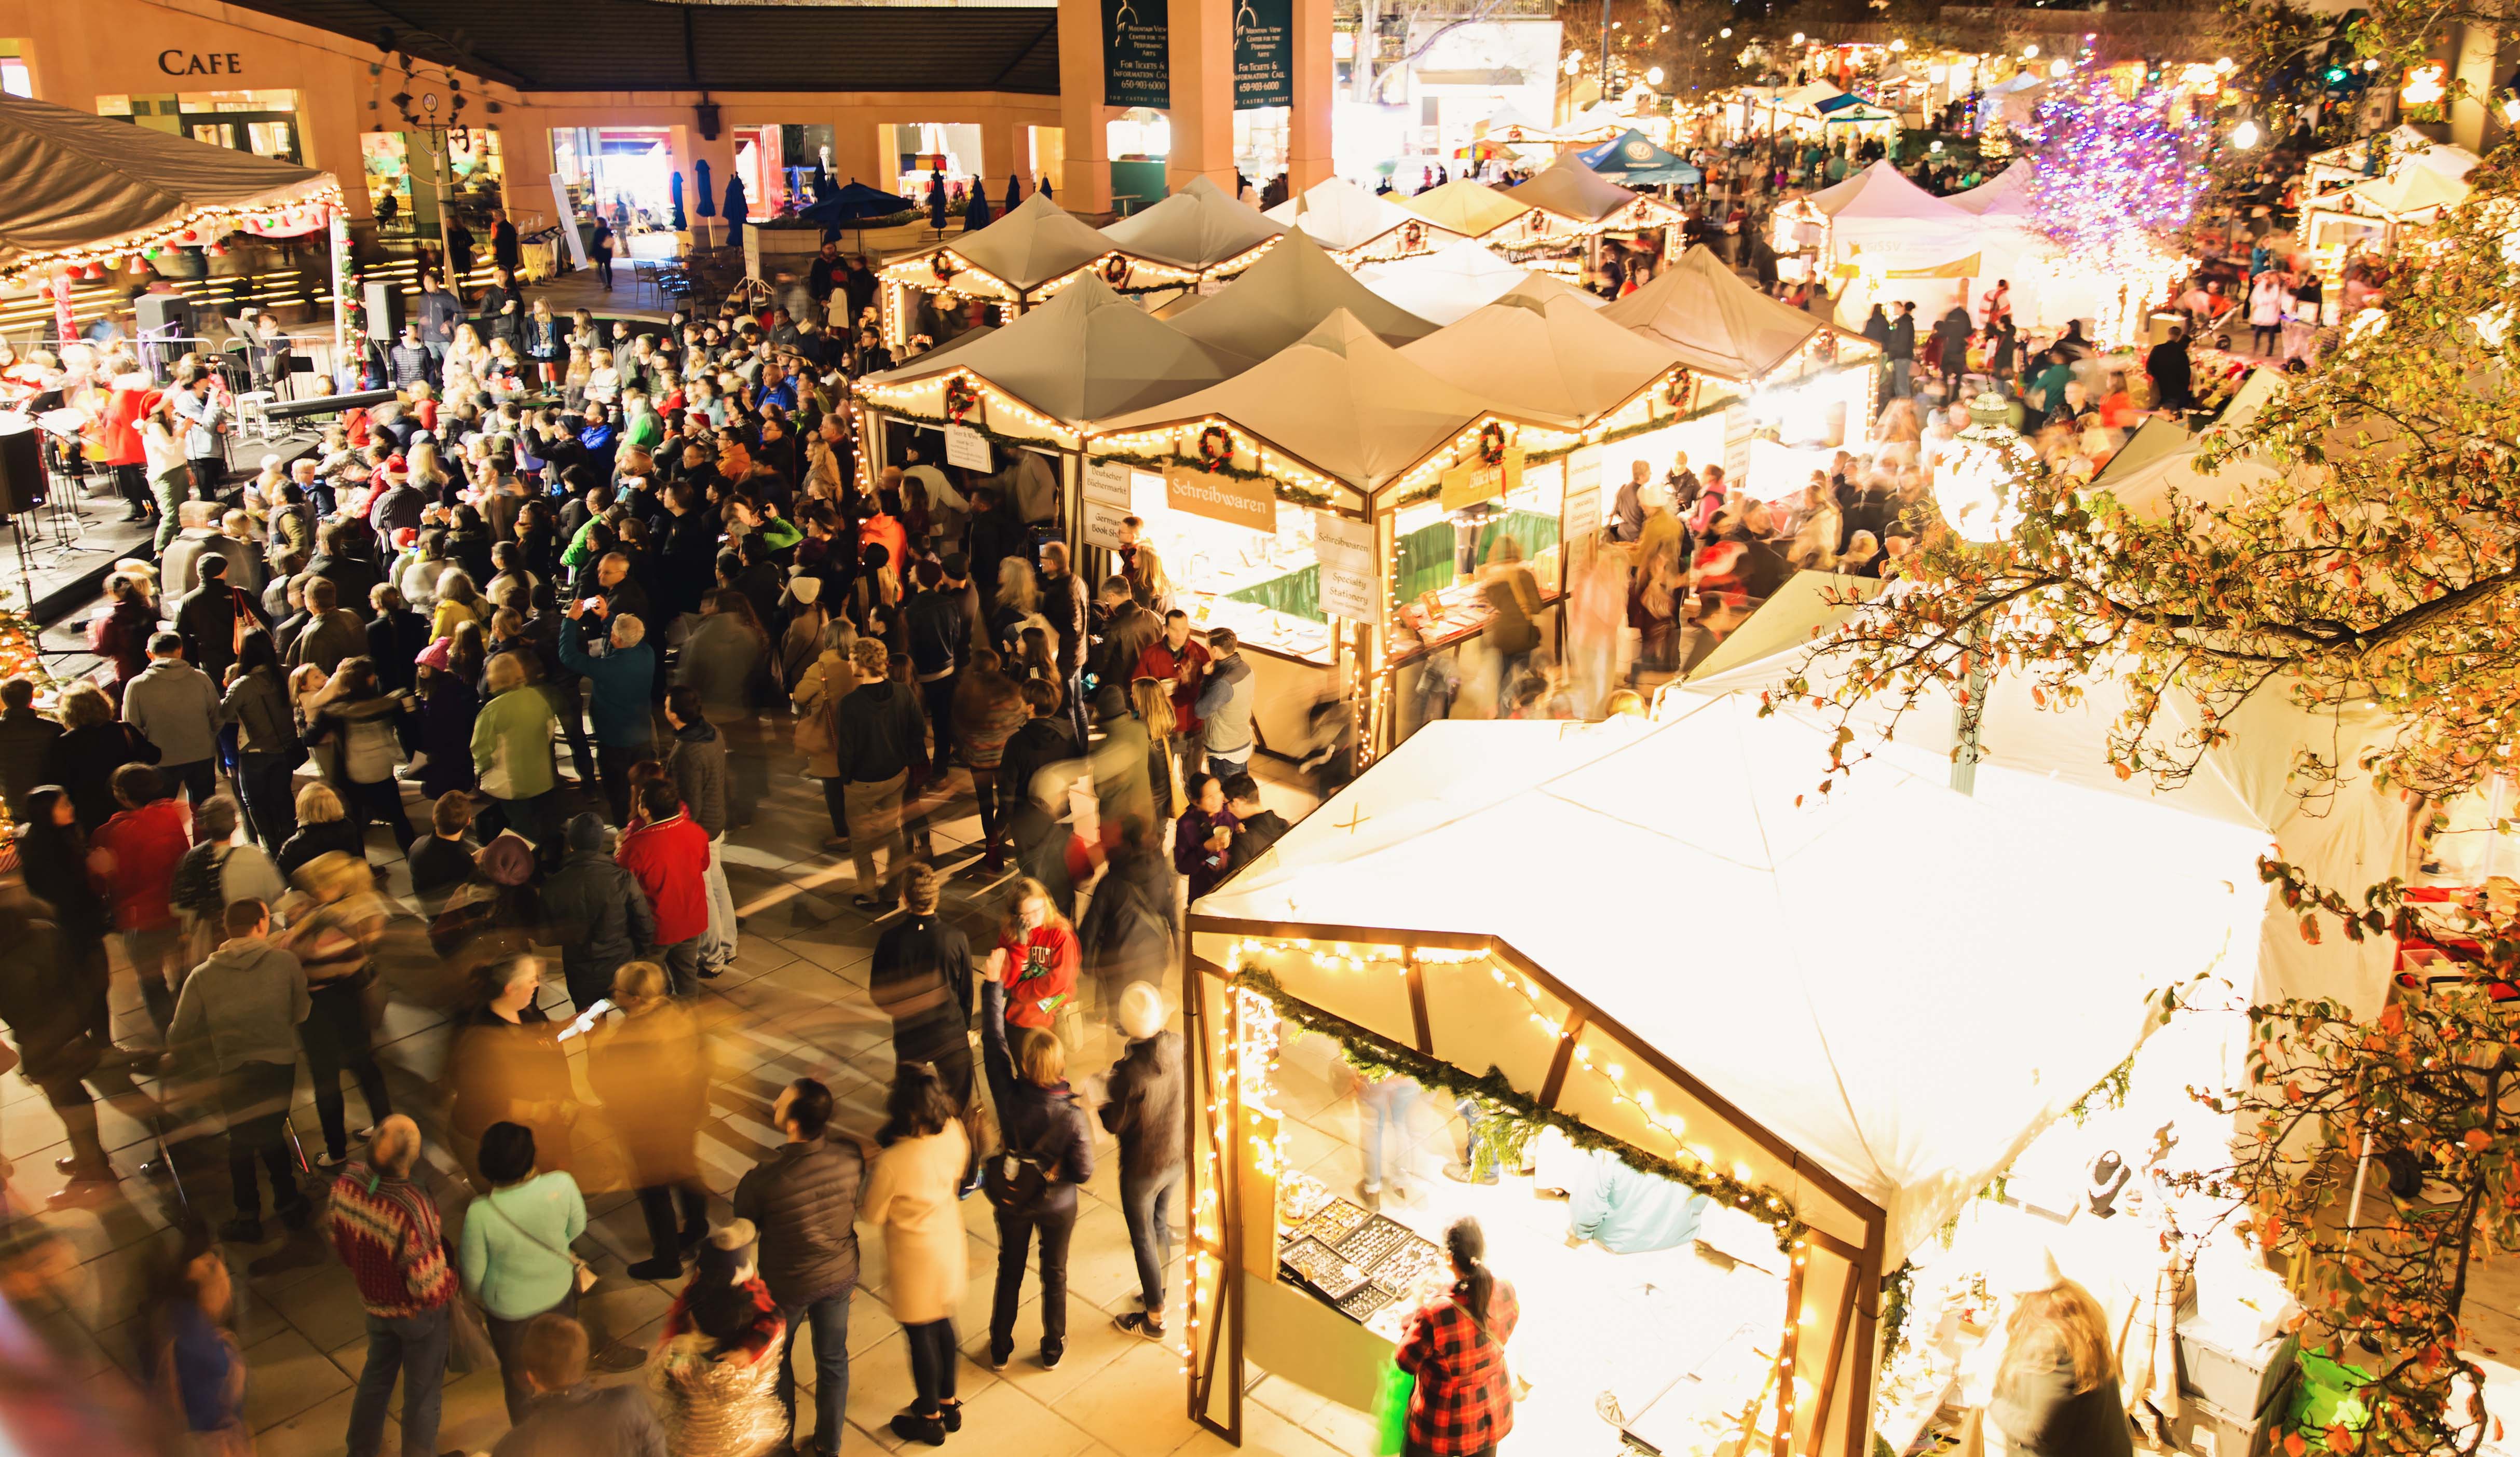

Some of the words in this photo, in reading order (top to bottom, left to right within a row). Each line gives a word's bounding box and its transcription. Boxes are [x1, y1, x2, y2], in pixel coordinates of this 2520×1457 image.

[1159, 61, 1165, 70] &
[1272, 61, 1277, 70] &
[1121, 79, 1166, 90] 650-903-6000
[1239, 81, 1279, 92] 650-903-6000
[1092, 467, 1122, 482] Deutscher
[1087, 478, 1127, 495] Büchermarkt
[1173, 478, 1266, 514] Schreibwaren
[1092, 524, 1108, 535] Book
[1318, 532, 1368, 553] Schreibwaren
[1332, 572, 1366, 590] Specialty
[1329, 587, 1368, 606] Stationery
